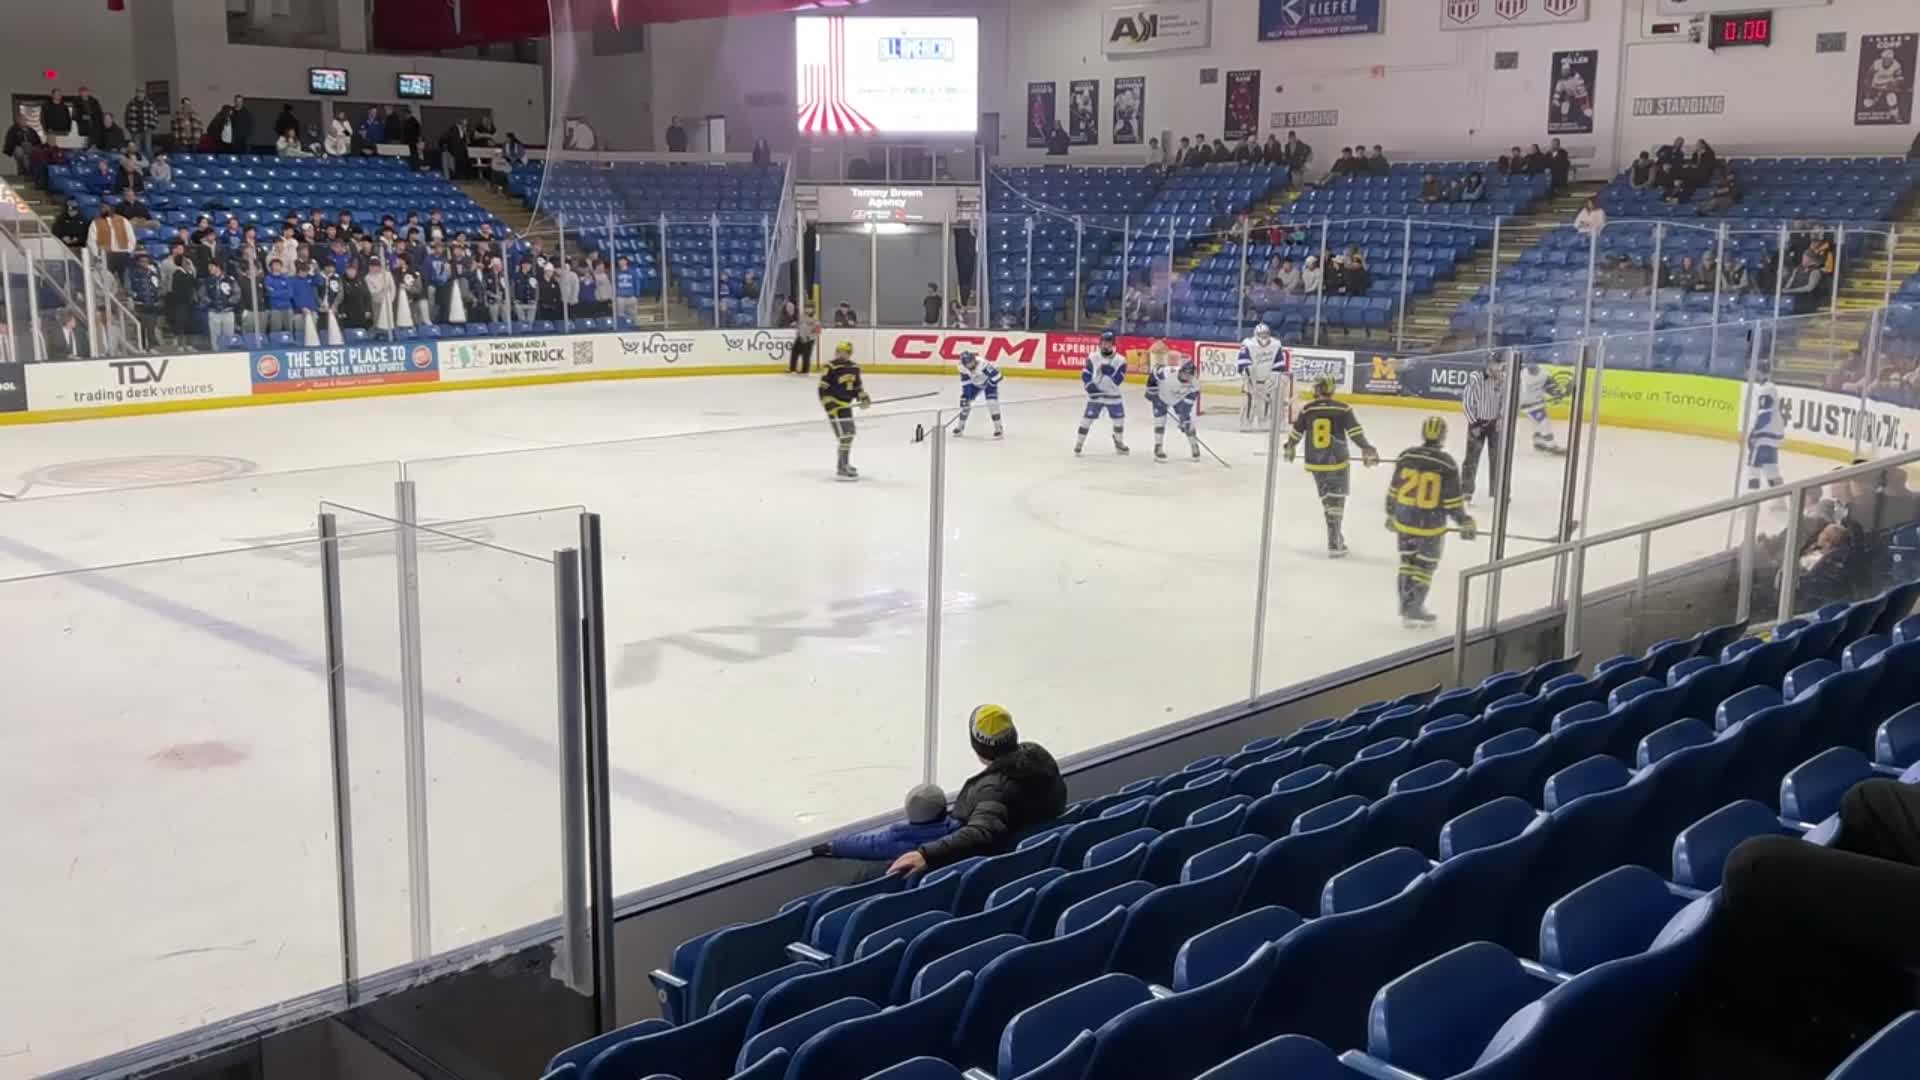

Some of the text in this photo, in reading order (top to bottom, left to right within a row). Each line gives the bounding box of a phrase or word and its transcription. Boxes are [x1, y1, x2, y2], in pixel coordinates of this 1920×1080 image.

[1724, 19, 1768, 41] 0:00
[1635, 96, 1724, 115] NO STANDING
[850, 188, 923, 199] Tammy Brown
[868, 198, 906, 208] Agency
[488, 340, 547, 350] TWO MEN AND A
[642, 332, 695, 363] Kroger
[747, 331, 793, 361] Kroge
[890, 334, 1041, 363] CCM
[286, 345, 406, 368] THE BEST PLACE TO
[488, 349, 565, 366] JUNK TRUCK
[109, 359, 169, 385] TDV
[73, 382, 214, 402] trading desk ventures
[1646, 388, 1661, 400] in
[1312, 417, 1332, 449] 8
[1397, 466, 1441, 510] 20
